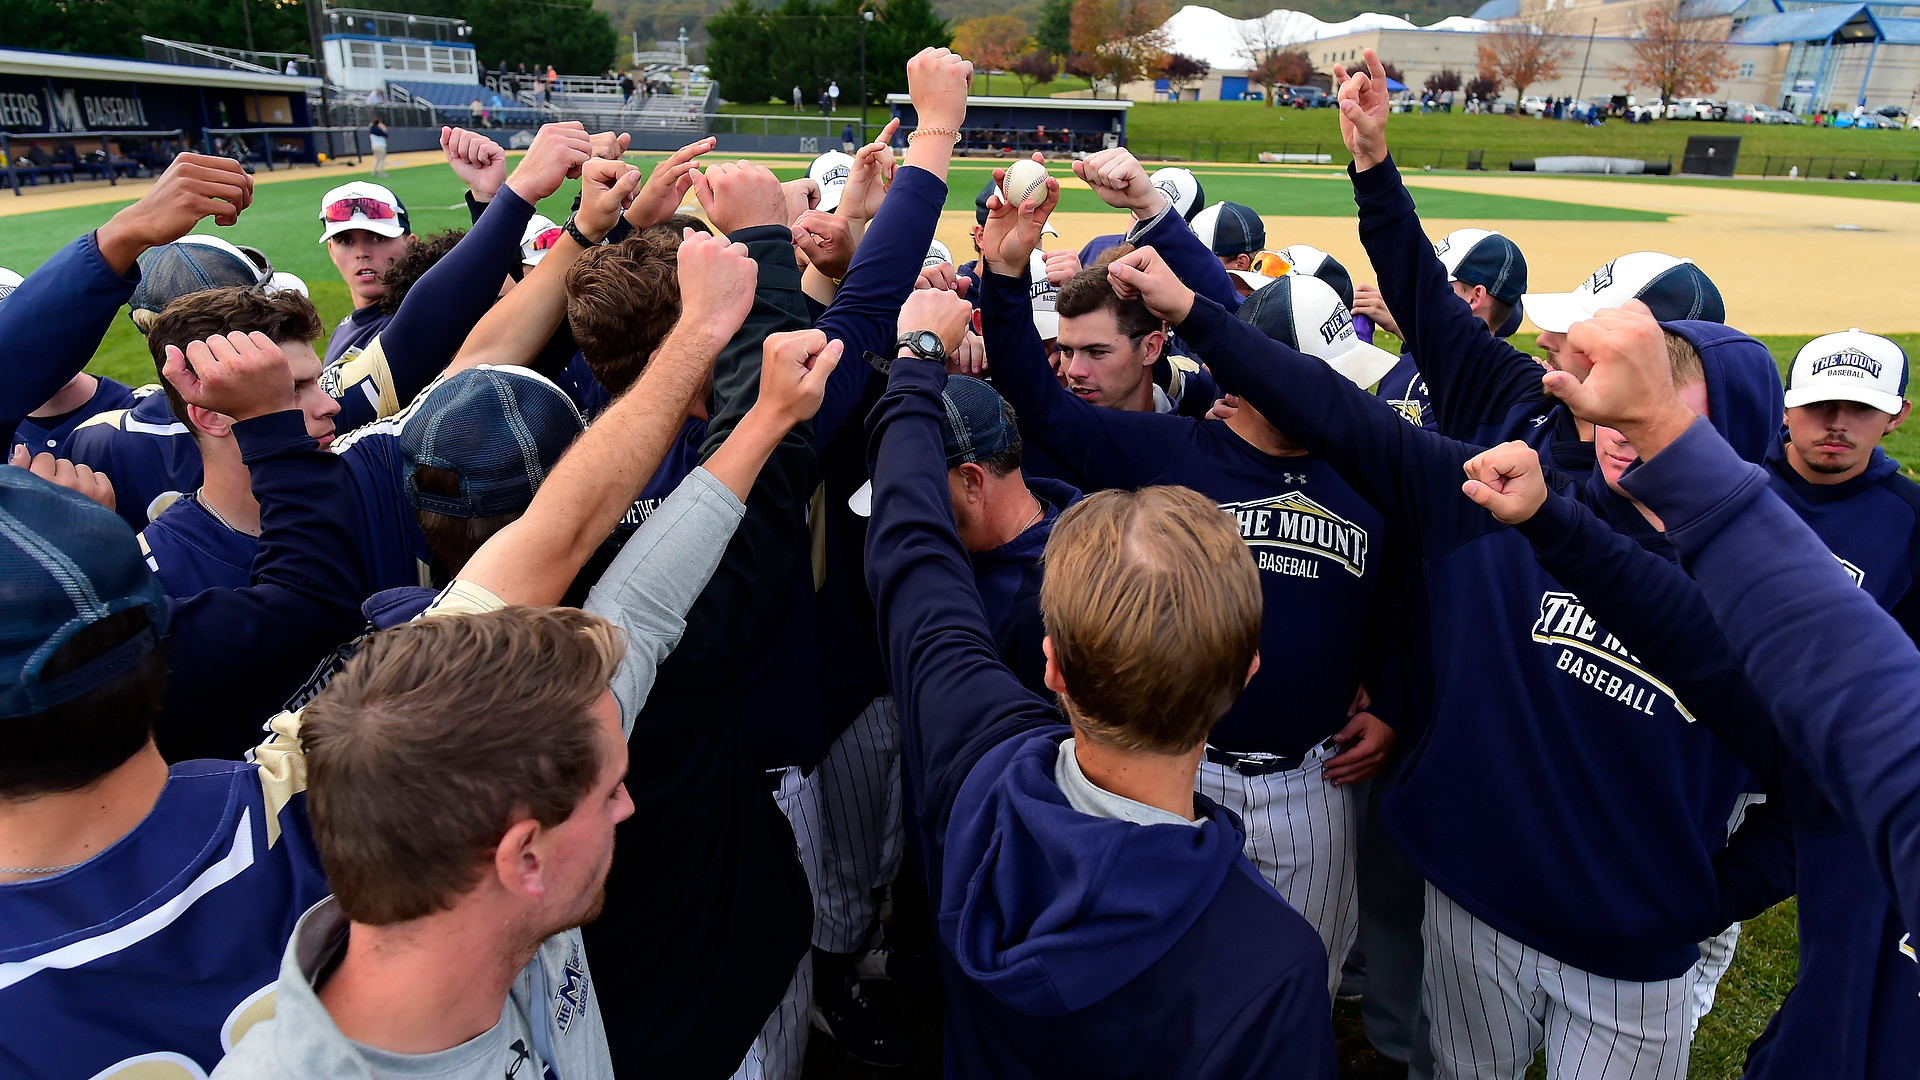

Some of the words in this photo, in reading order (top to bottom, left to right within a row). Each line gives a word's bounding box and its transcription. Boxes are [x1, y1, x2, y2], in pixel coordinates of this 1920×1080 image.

[800, 137, 819, 153] M
[1031, 281, 1049, 298] THE
[1320, 315, 1343, 342] THE
[1812, 354, 1839, 375] THE
[1839, 353, 1882, 378] MOUNT
[1827, 369, 1865, 379] BASEBALL
[1277, 510, 1364, 567] MOUNT
[1258, 551, 1320, 579] BASEBALL
[1540, 597, 1598, 642] THE
[1556, 648, 1657, 717] BASEBALL
